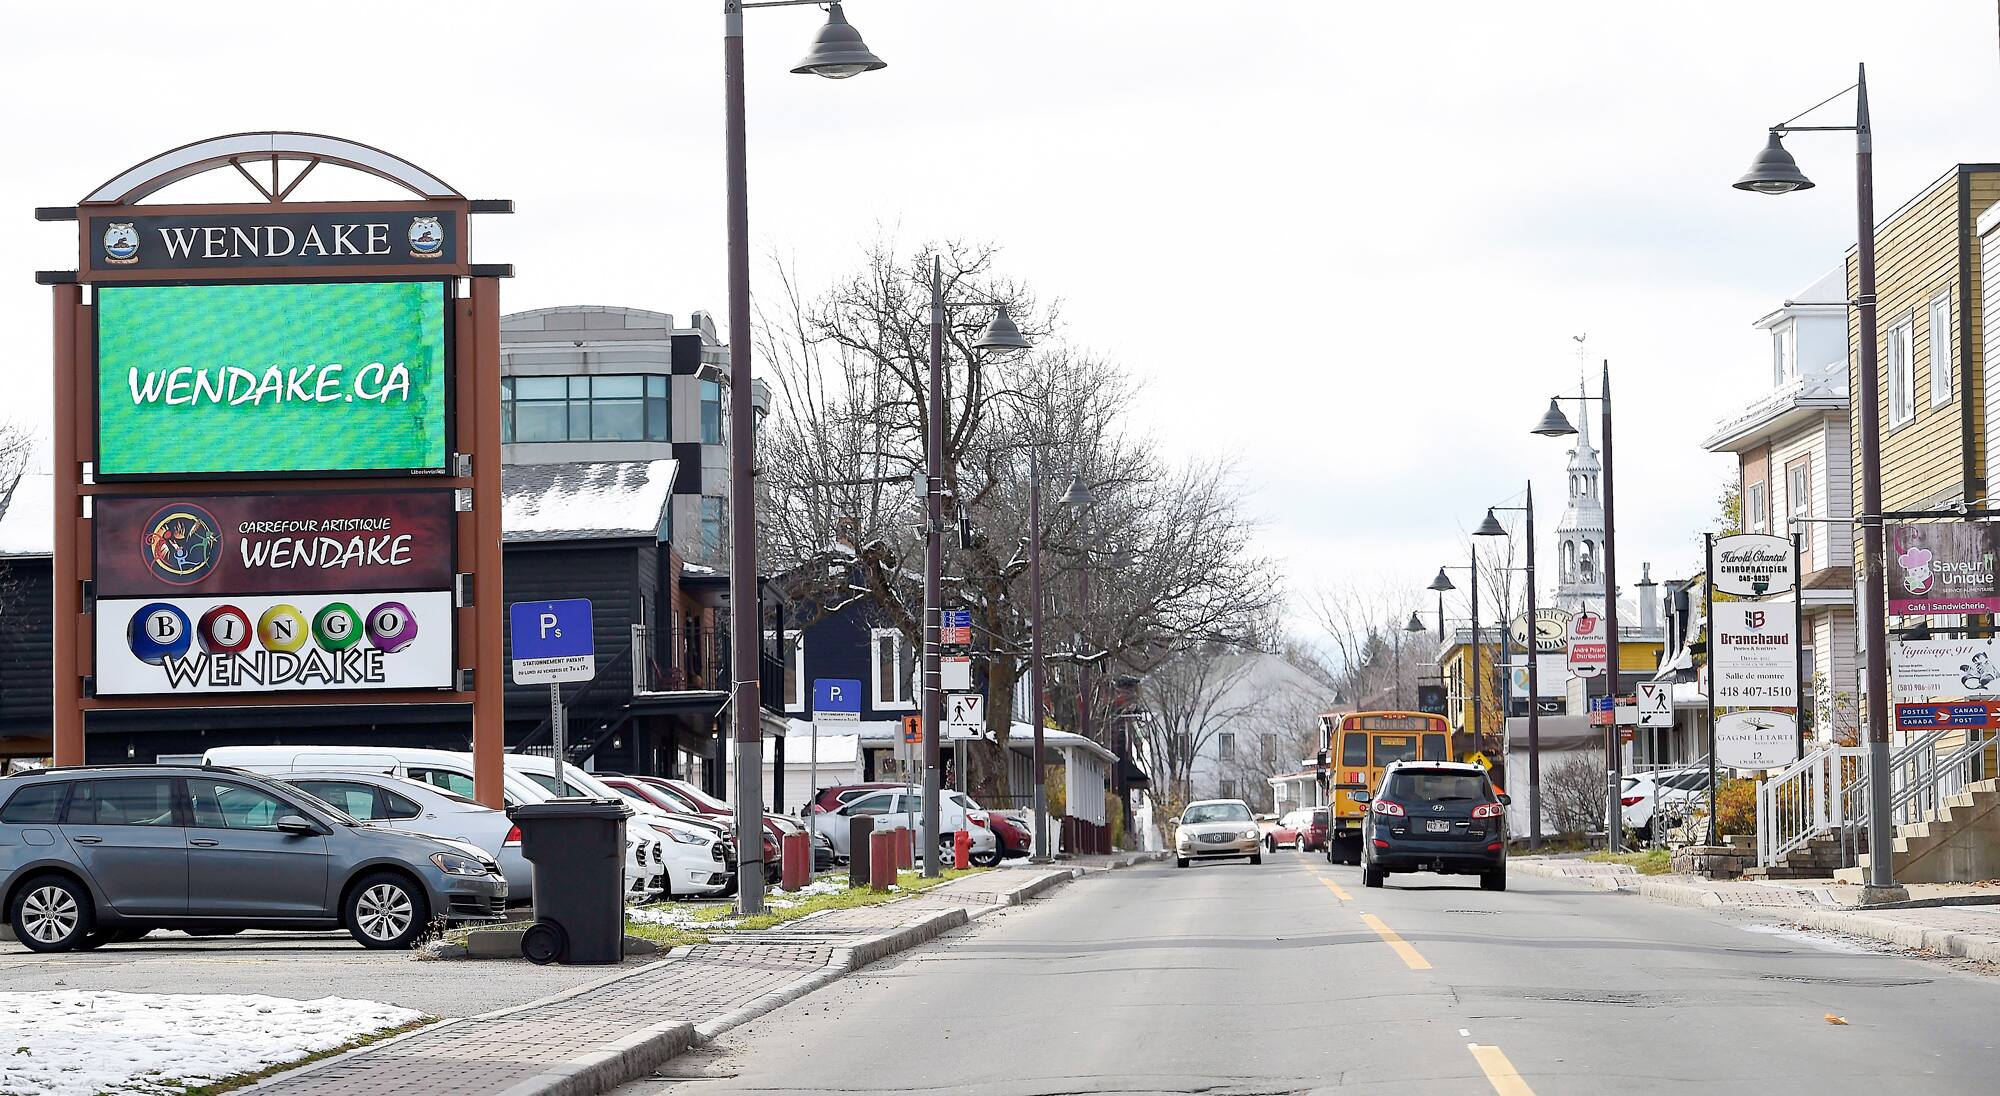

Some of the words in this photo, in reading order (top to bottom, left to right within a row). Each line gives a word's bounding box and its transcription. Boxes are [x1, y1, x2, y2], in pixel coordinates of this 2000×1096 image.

[158, 223, 392, 259] WENDAKE
[128, 362, 410, 406] WENDAKE.CA
[238, 520, 318, 533] CARREFOUR
[320, 518, 391, 532] ARTISTIQUE
[240, 534, 412, 568] WENDAKE
[1720, 550, 1753, 563] Harold
[1753, 550, 1788, 563] Chantal
[1721, 565, 1788, 573] CHIROPRATICIEN
[1933, 560, 1983, 572] Saveur
[1942, 573, 1994, 585] Unique
[1907, 603, 1926, 611] Café
[1932, 602, 1985, 611] Sandwicherie
[155, 612, 399, 640] BINGO
[1720, 633, 1789, 645] Branchaud
[161, 648, 386, 689] WENDAKE
[522, 659, 564, 667] STATIONNEMENT
[1725, 672, 1744, 680] Salle
[1745, 672, 1755, 680] de
[1720, 686, 1739, 696] 418
[1742, 686, 1792, 696] 407-1510
[1753, 752, 1763, 760] 12
